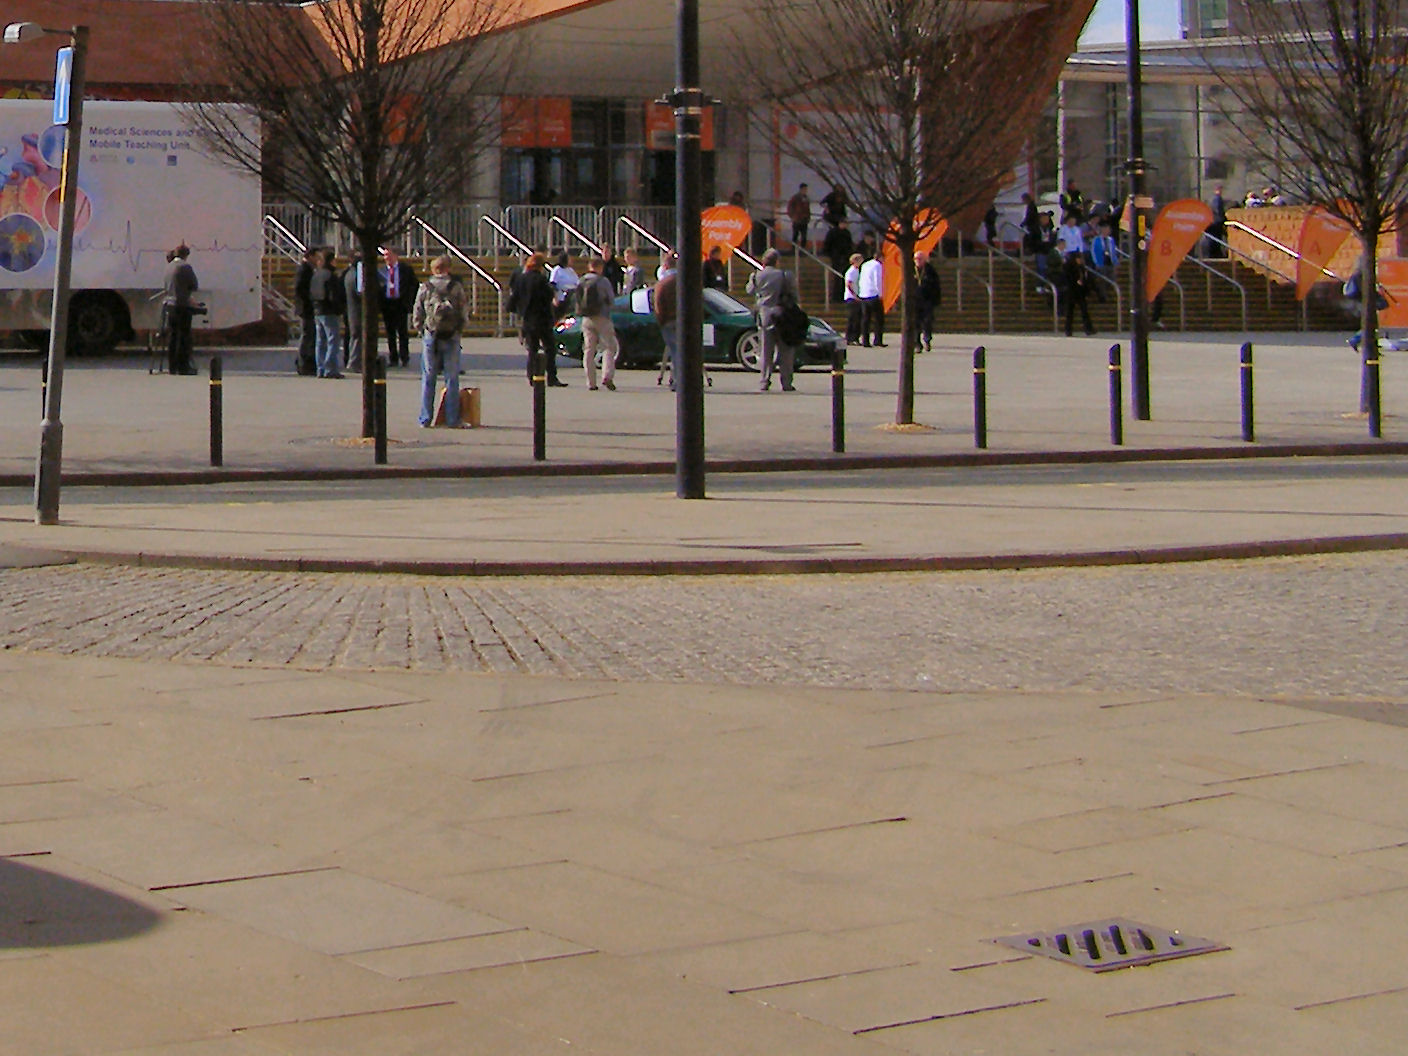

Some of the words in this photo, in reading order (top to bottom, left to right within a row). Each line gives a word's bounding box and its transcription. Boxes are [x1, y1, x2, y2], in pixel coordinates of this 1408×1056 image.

[89, 126, 127, 136] Medical
[129, 126, 172, 137] Sciences
[89, 139, 120, 149] Mobile
[125, 140, 167, 152] Teaching
